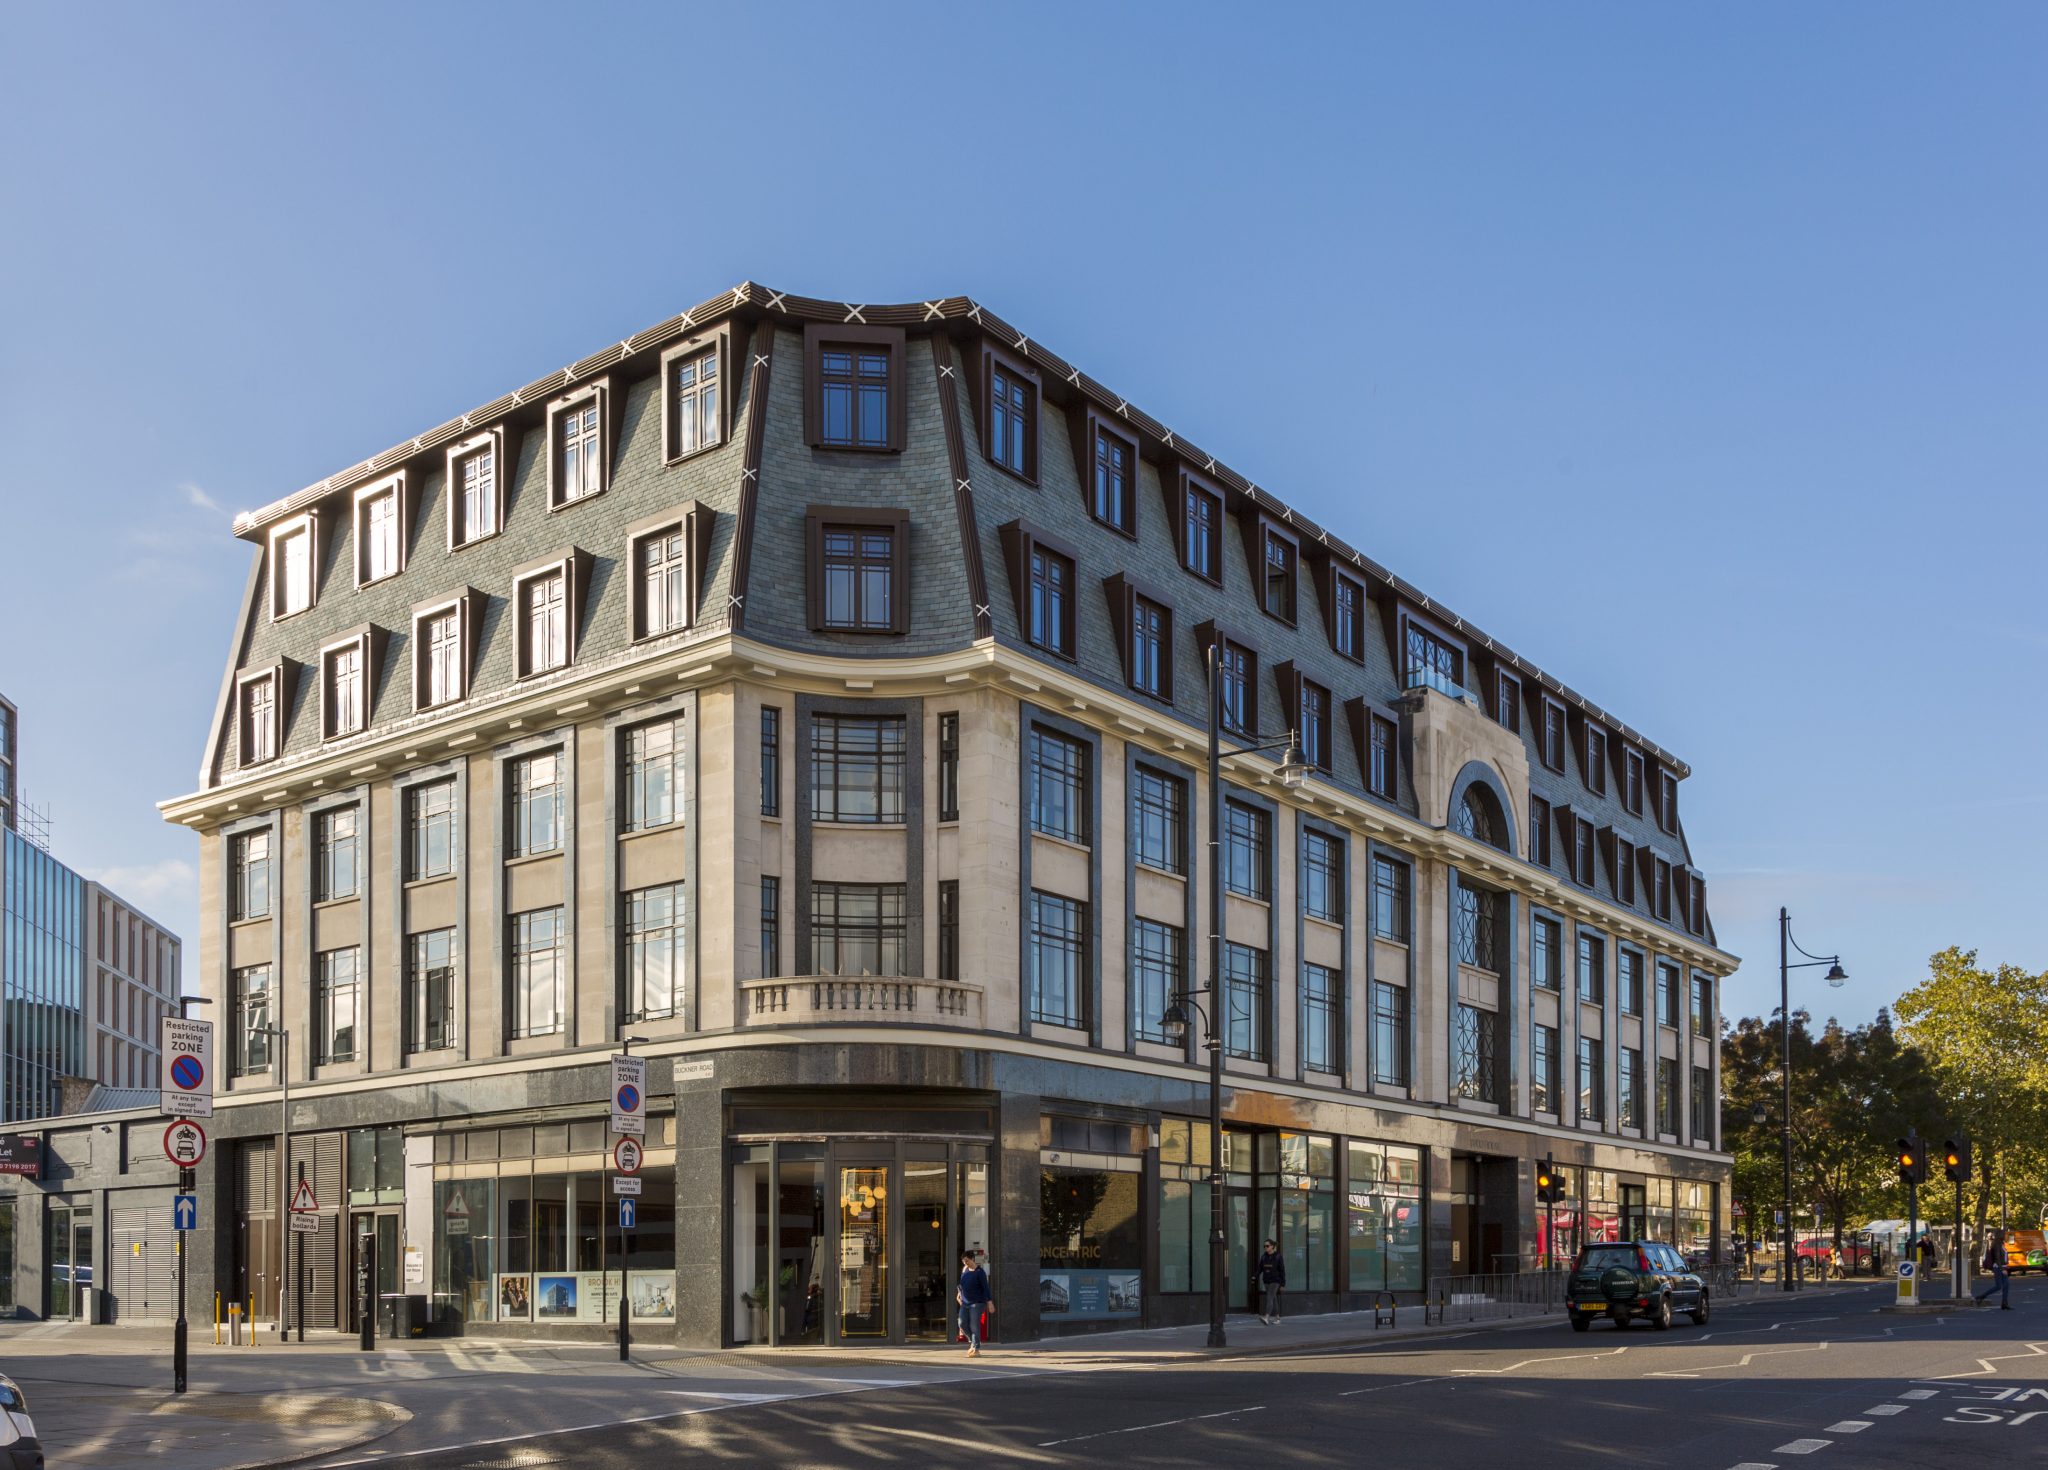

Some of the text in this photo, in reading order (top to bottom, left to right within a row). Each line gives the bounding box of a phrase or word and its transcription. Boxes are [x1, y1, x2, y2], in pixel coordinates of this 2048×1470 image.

[166, 1020, 210, 1033] Restricted
[171, 1032, 204, 1043] parking
[171, 1041, 203, 1053] ZONE
[614, 1057, 644, 1067] Restricted
[617, 1066, 640, 1074] parking
[674, 1063, 713, 1074] BUCKNER ROAD
[617, 1073, 640, 1083] ZONE
[174, 1106, 193, 1114] signed
[295, 1216, 315, 1224] Rising
[292, 1222, 317, 1230] bollards
[1040, 1245, 1101, 1259] NCENTRIC
